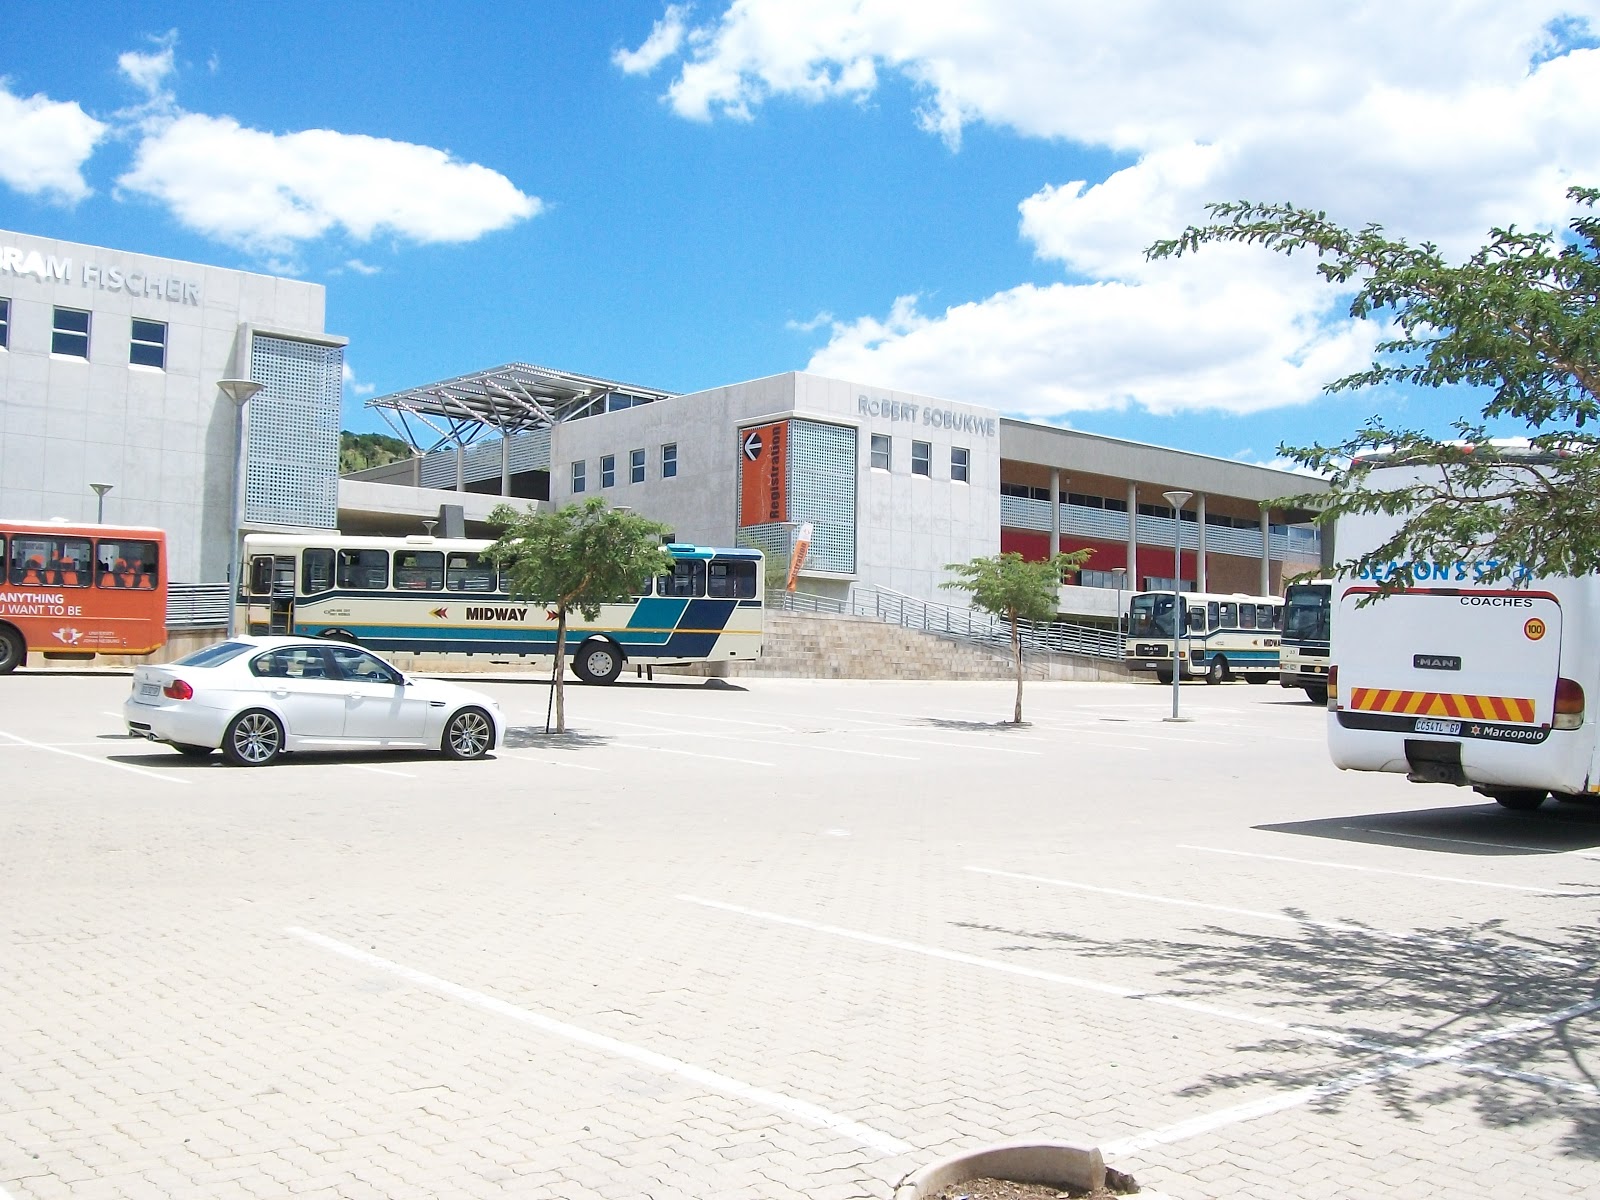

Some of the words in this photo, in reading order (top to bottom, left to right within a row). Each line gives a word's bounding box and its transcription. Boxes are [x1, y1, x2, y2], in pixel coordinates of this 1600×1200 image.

[83, 261, 199, 306] FISCHER
[858, 395, 919, 423] ROBERT
[923, 406, 996, 437] SOBUKWE
[769, 425, 782, 519] Registration
[0, 592, 64, 604] ANYTHING
[1460, 596, 1533, 608] COACHES
[8, 604, 45, 615] WANT
[47, 605, 64, 615] TO
[67, 606, 82, 616] BE
[465, 606, 528, 622] MIDWAY
[1527, 624, 1542, 635] 100
[1264, 638, 1280, 647] MIDWA
[1419, 658, 1454, 667] MAN
[1449, 724, 1460, 734] GP
[1483, 726, 1544, 741] Marcopolo
